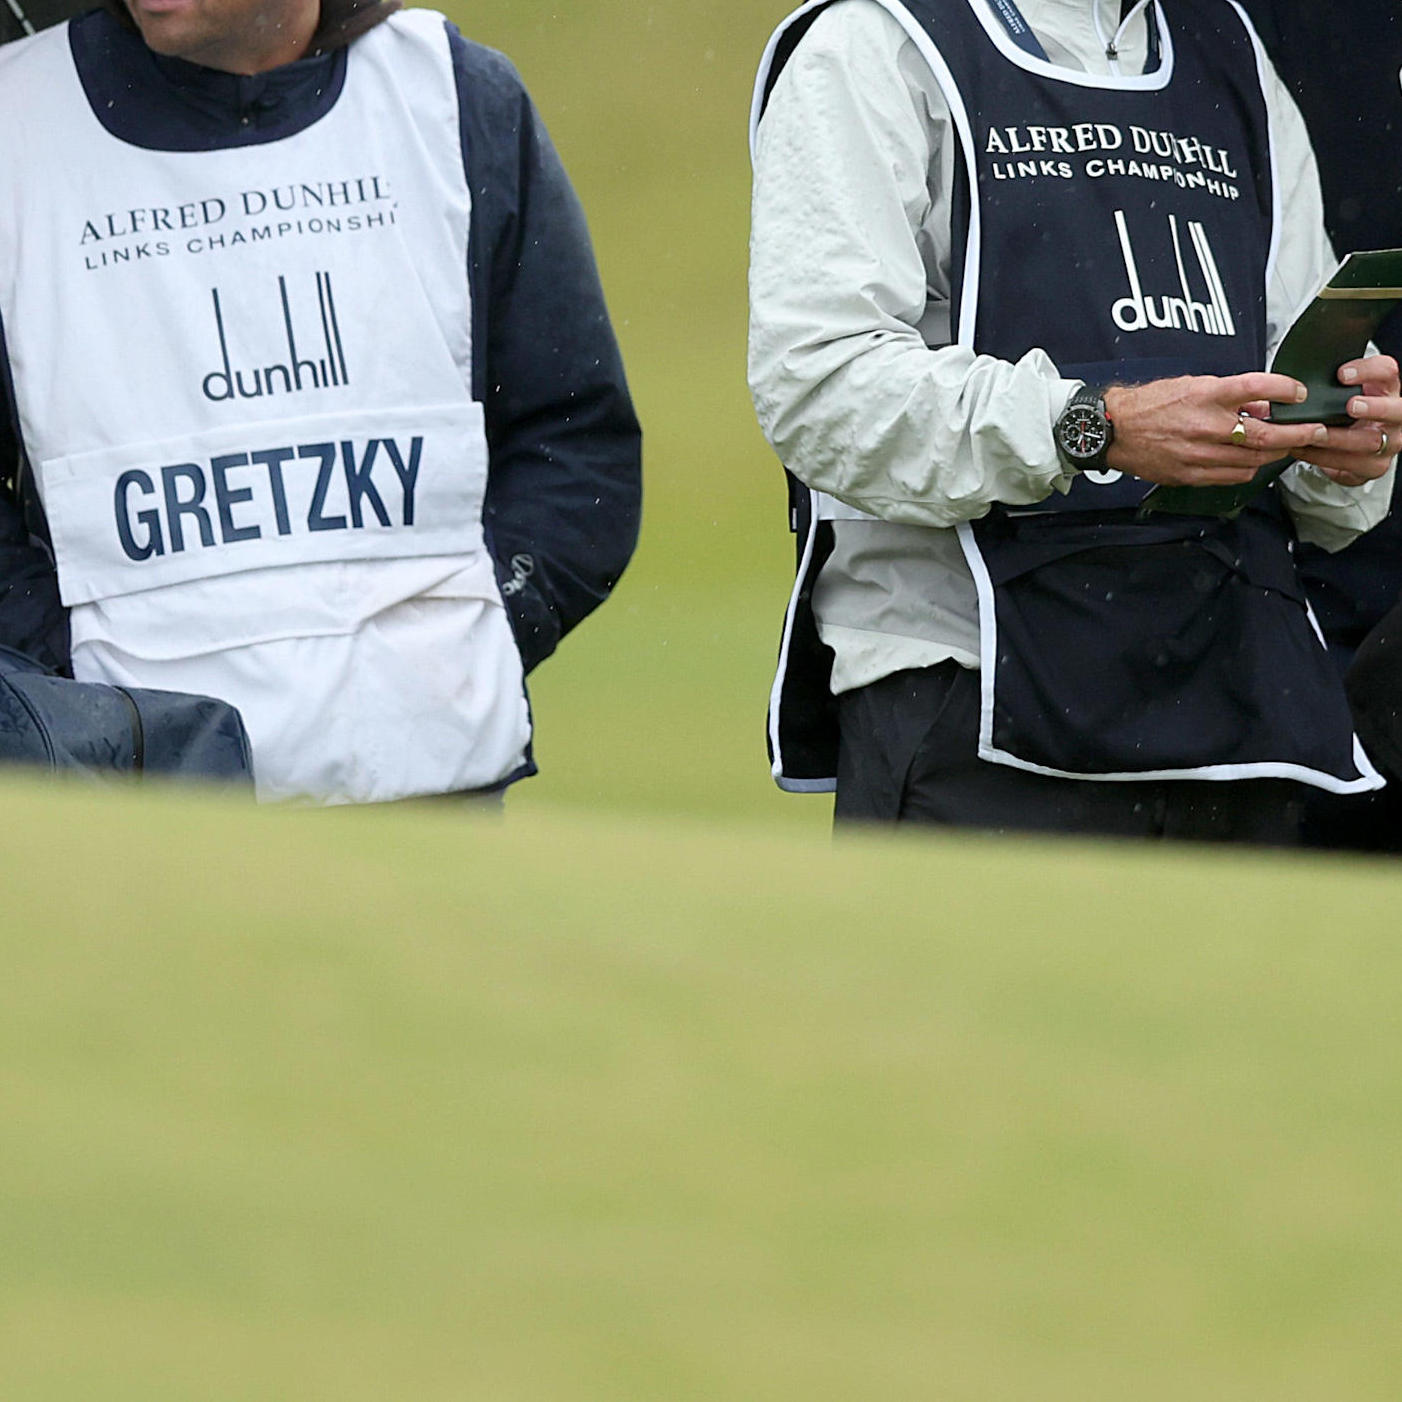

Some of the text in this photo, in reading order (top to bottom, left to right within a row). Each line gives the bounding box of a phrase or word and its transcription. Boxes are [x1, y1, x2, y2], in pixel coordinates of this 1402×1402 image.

[985, 123, 1123, 154] ALFRED
[79, 176, 398, 245] ALFRED DUNHIL
[992, 158, 1240, 201] LINKS CHAMPIONHIP
[84, 210, 396, 270] LINKS CHAMPIONSHI
[1111, 210, 1236, 336] dunhill
[202, 271, 349, 402] dunhill
[114, 436, 424, 562] GRETZKY
